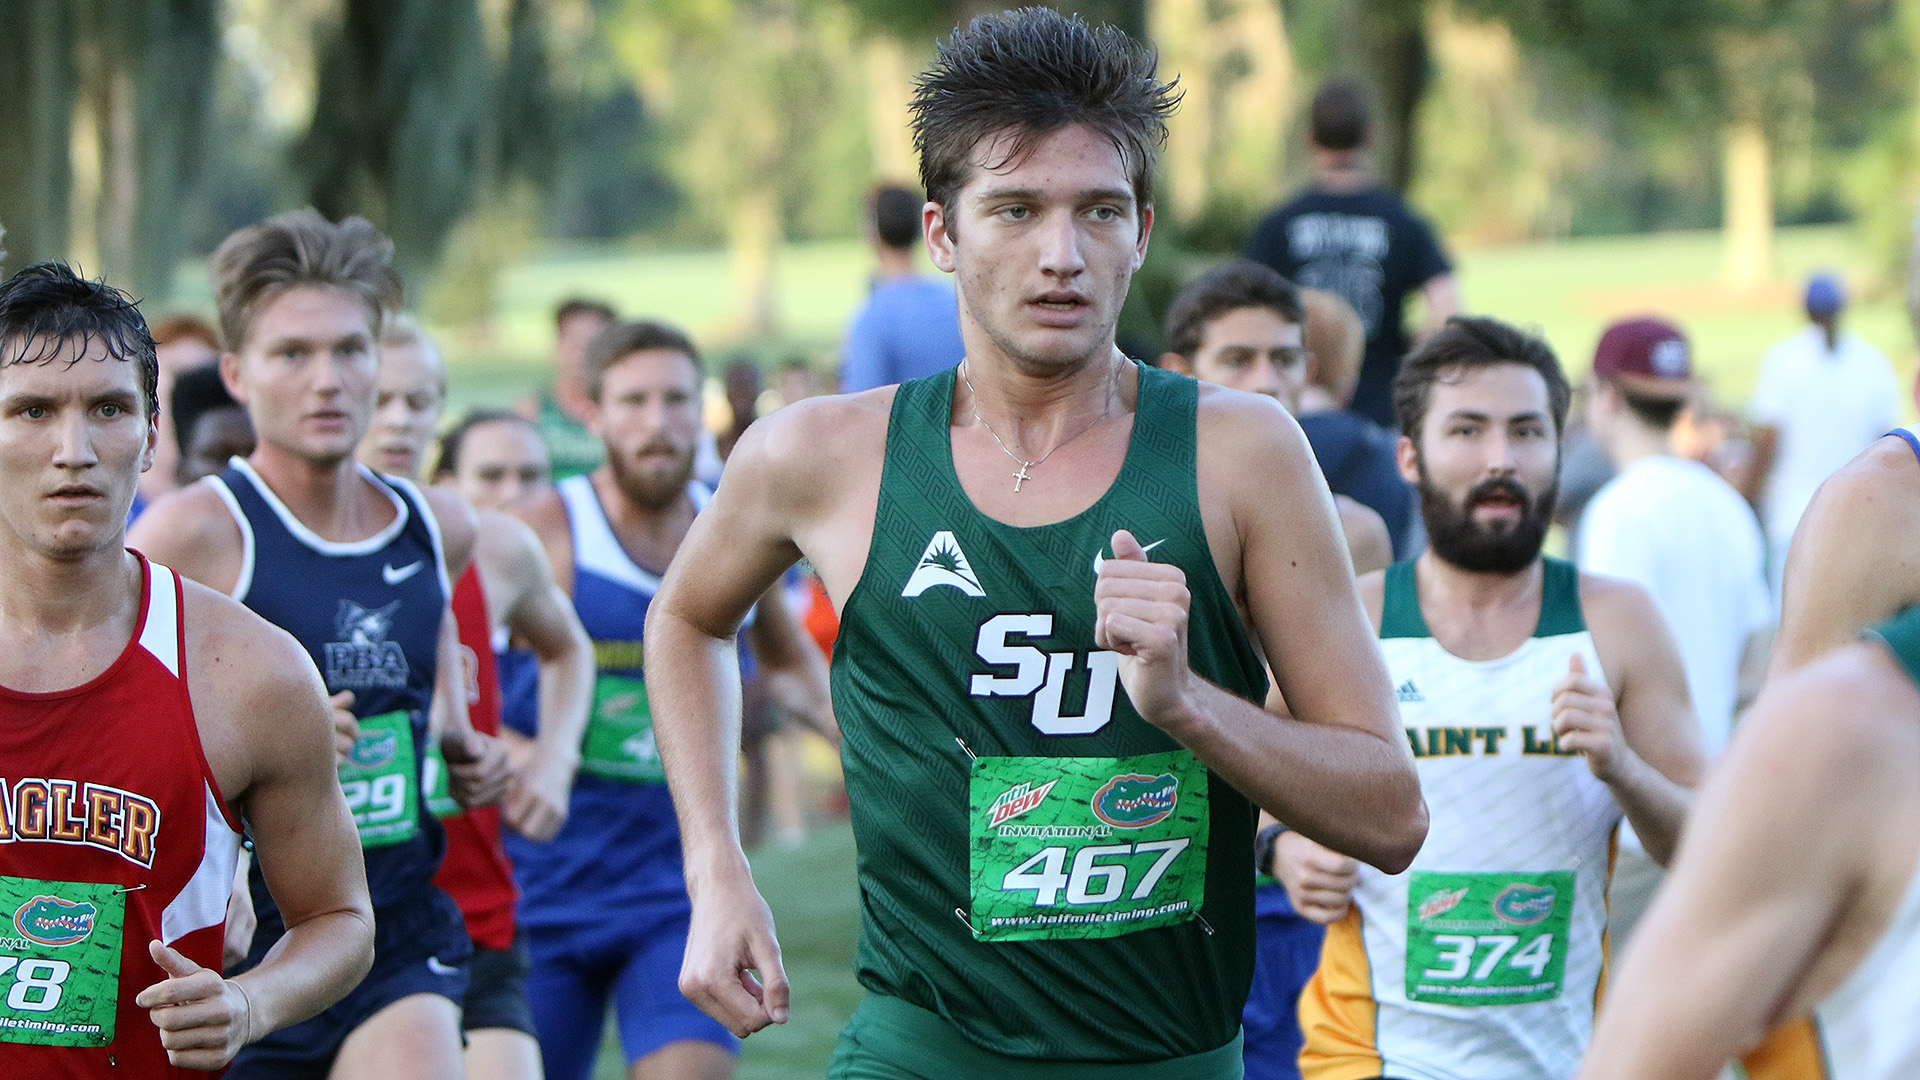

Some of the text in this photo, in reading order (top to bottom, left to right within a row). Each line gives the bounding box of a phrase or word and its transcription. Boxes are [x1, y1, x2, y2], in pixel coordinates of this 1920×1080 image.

[969, 612, 1119, 737] SU
[1405, 724, 1508, 760] INT
[998, 824, 1113, 840] INVITATIONAL
[1002, 838, 1191, 907] 467
[990, 900, 1189, 928] www.halfmiletiming.com
[1423, 932, 1554, 981] 374
